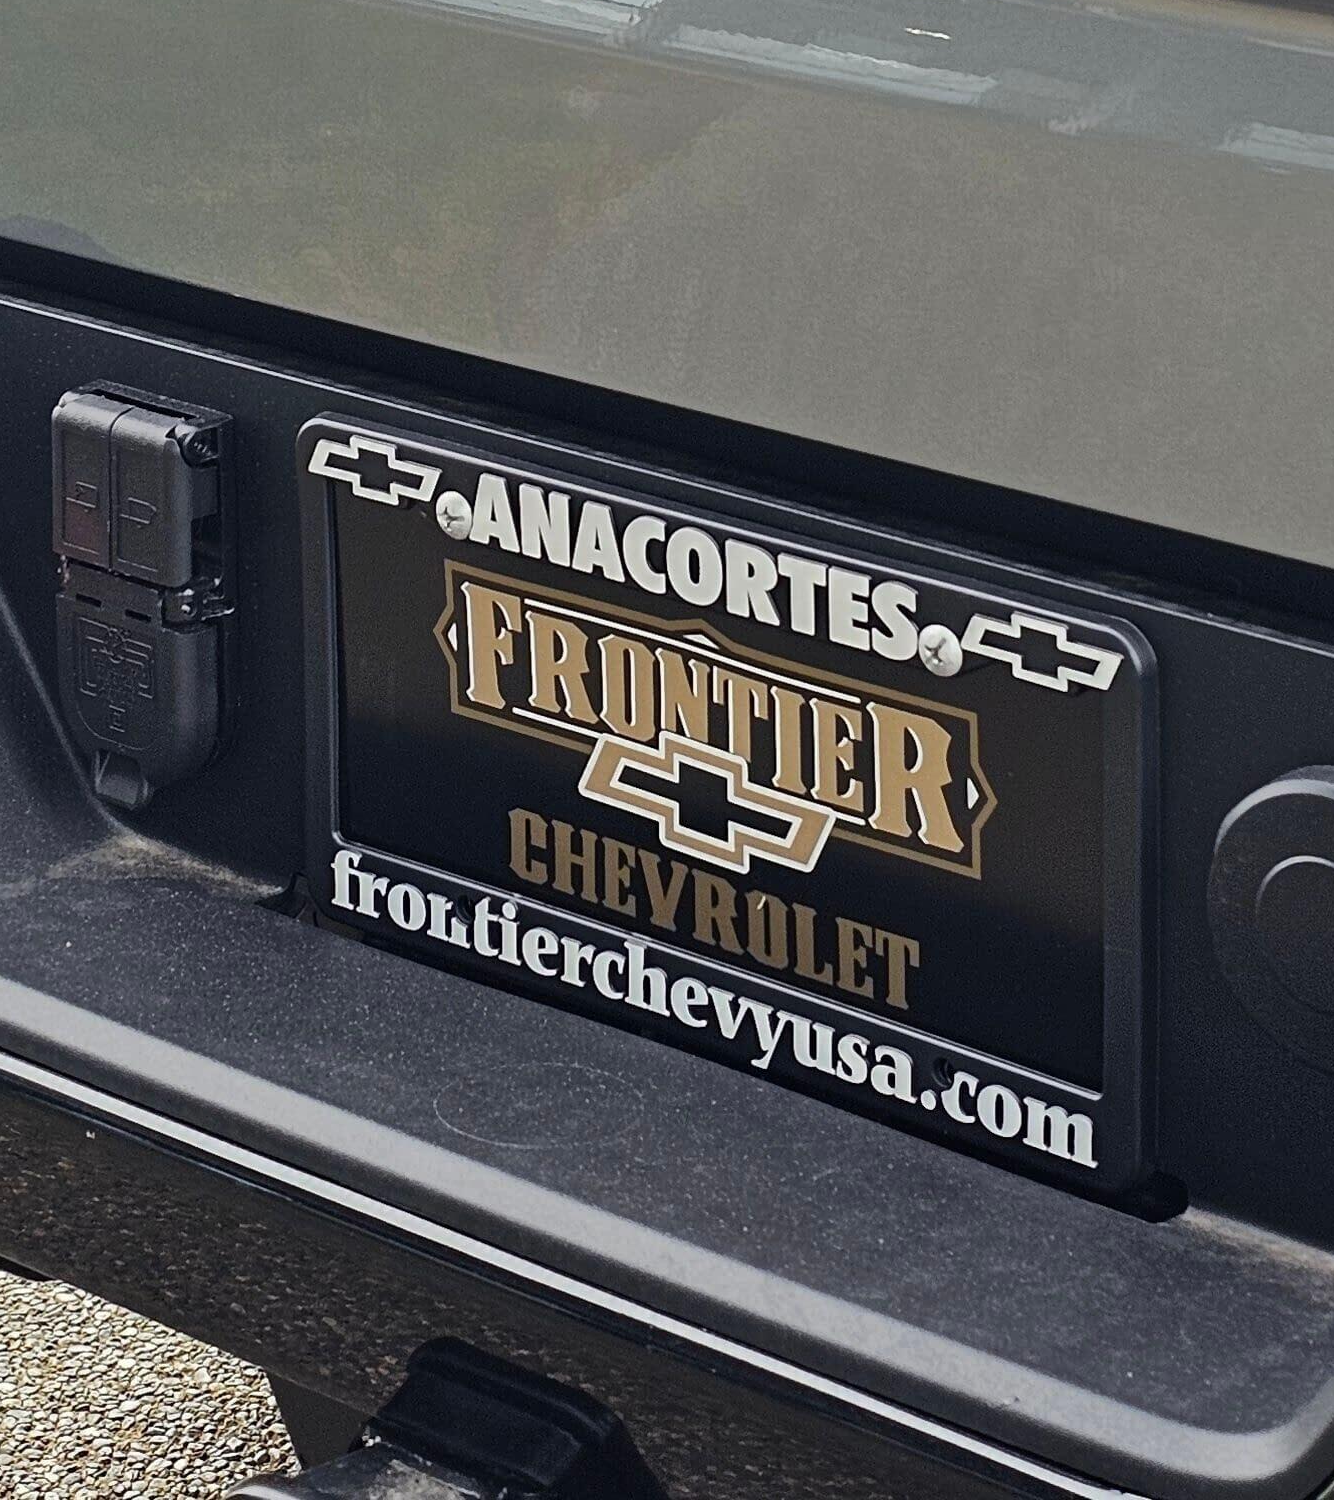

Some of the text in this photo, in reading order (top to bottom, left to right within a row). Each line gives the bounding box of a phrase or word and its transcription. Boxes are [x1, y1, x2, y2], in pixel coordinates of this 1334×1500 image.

[469, 473, 920, 660] ANACORTES
[461, 581, 965, 855] FRONTIER
[330, 850, 1098, 1169] frontierchevyusa.com
[507, 807, 920, 1011] CHEVROLET
